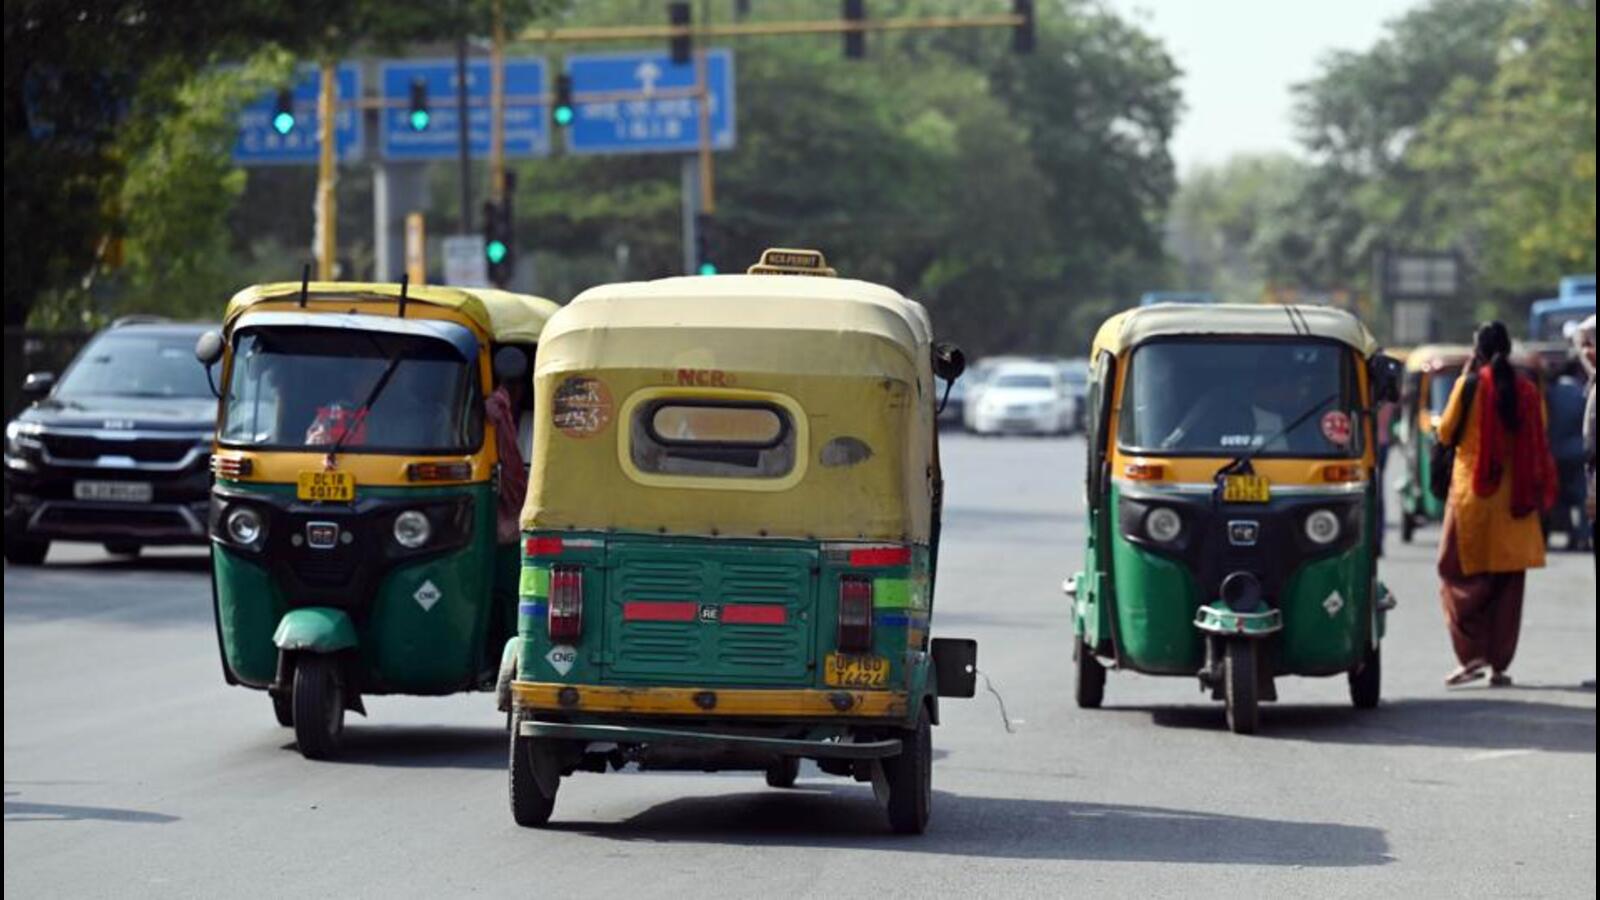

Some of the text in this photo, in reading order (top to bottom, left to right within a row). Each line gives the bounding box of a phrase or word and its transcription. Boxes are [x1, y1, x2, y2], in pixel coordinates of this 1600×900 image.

[677, 369, 725, 387] NCR
[703, 608, 718, 619] RE
[552, 652, 574, 663] CNG
